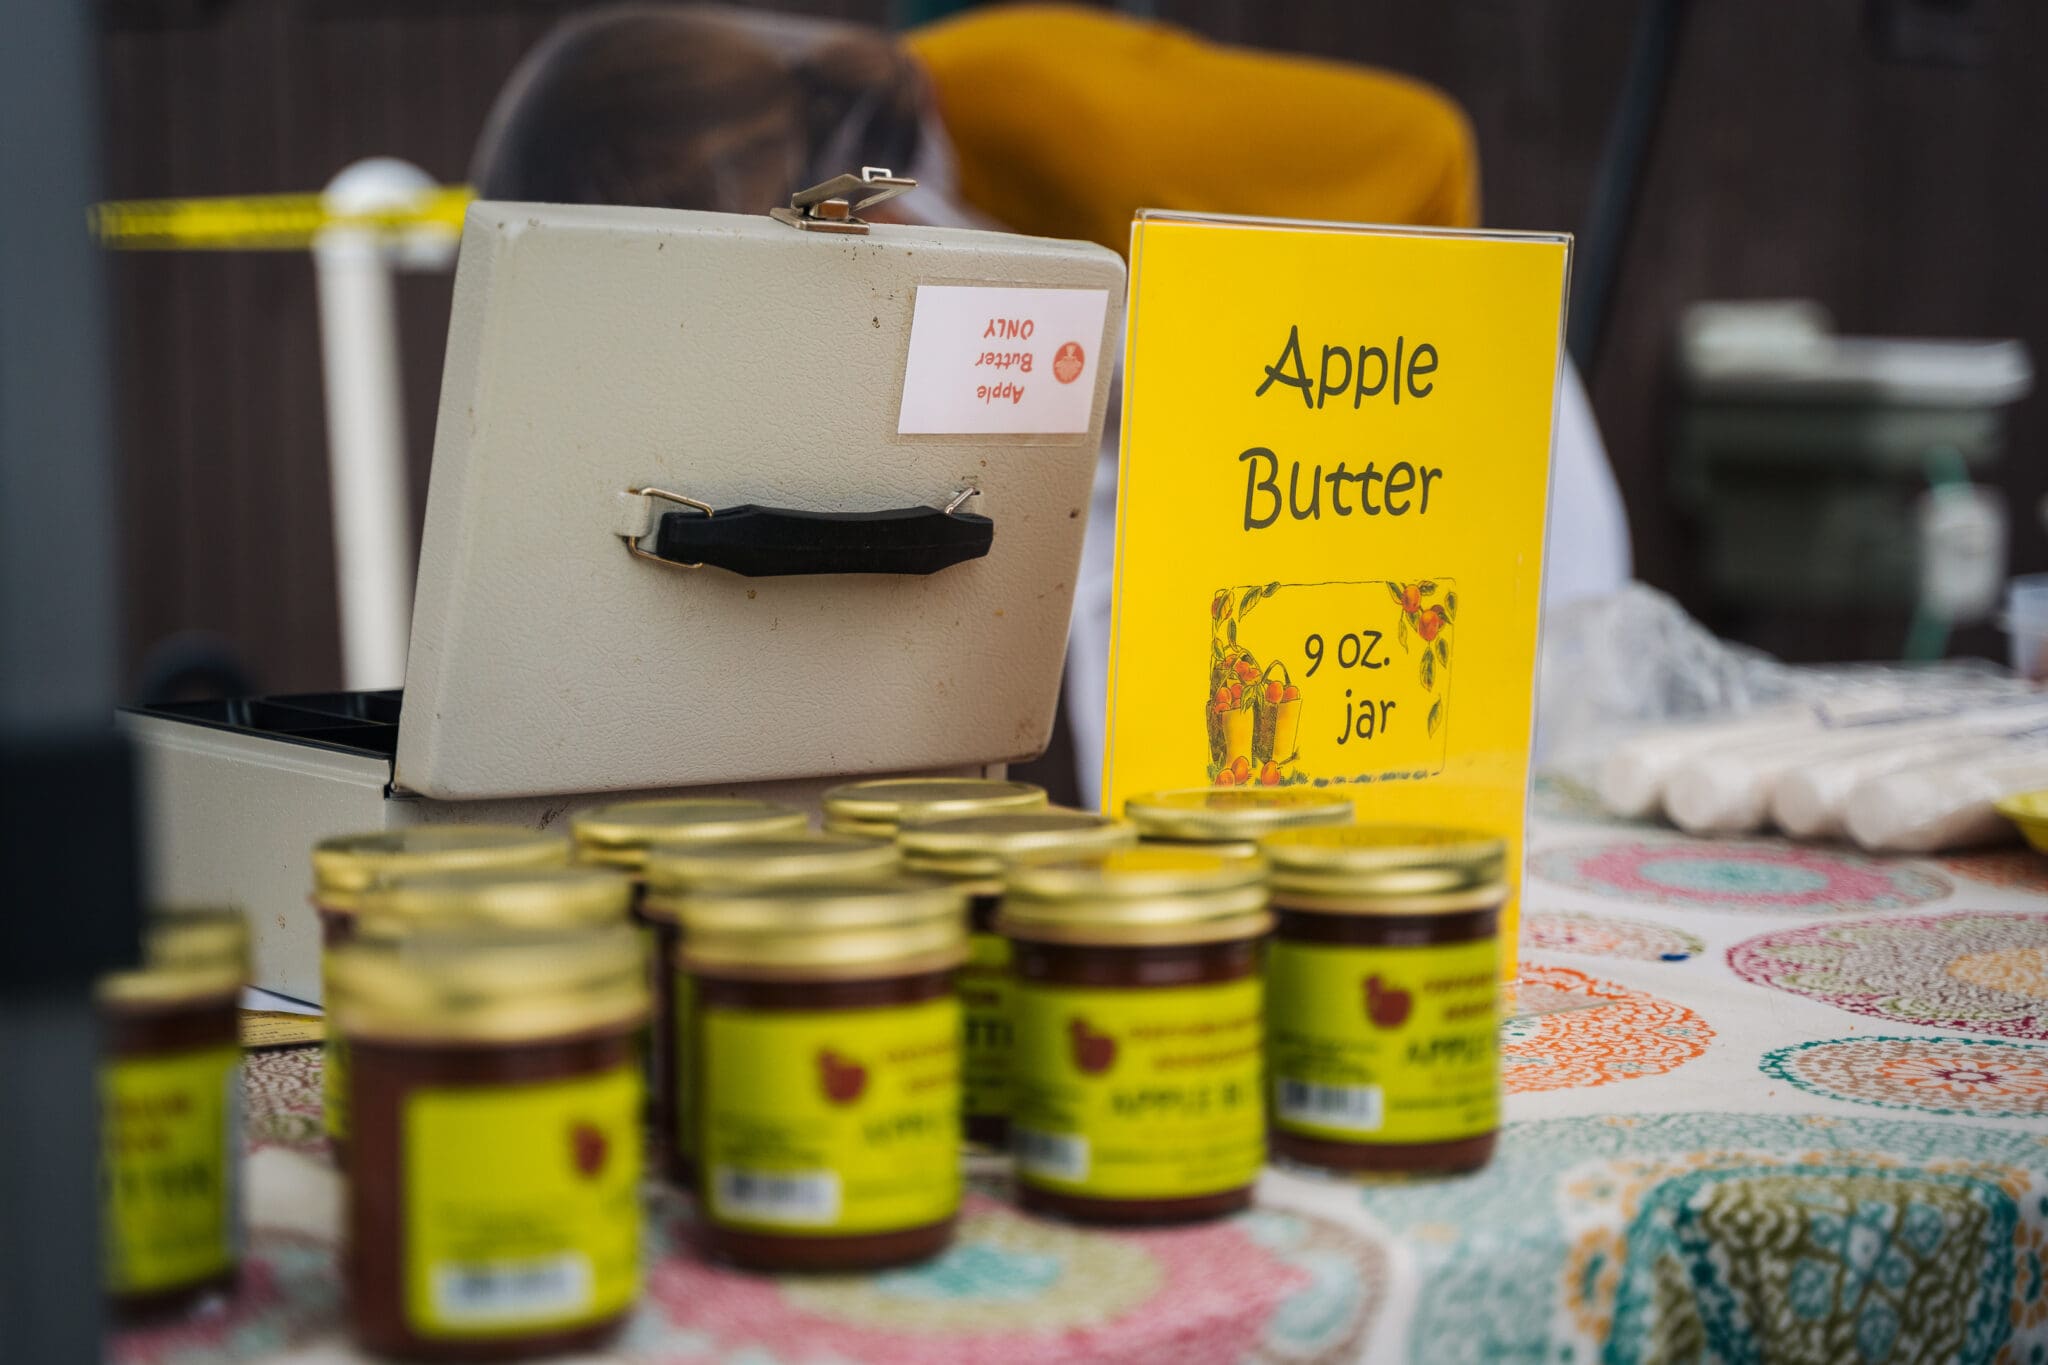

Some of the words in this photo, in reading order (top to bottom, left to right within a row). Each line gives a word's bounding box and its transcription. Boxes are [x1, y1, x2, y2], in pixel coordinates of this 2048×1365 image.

[983, 318, 1035, 341] ONLY
[975, 352, 1034, 374] Butter
[1256, 325, 1439, 409] Apple
[977, 382, 1025, 405] Apple
[1239, 447, 1443, 532] Butter
[1305, 633, 1324, 678] 9
[1336, 689, 1396, 745] jar
